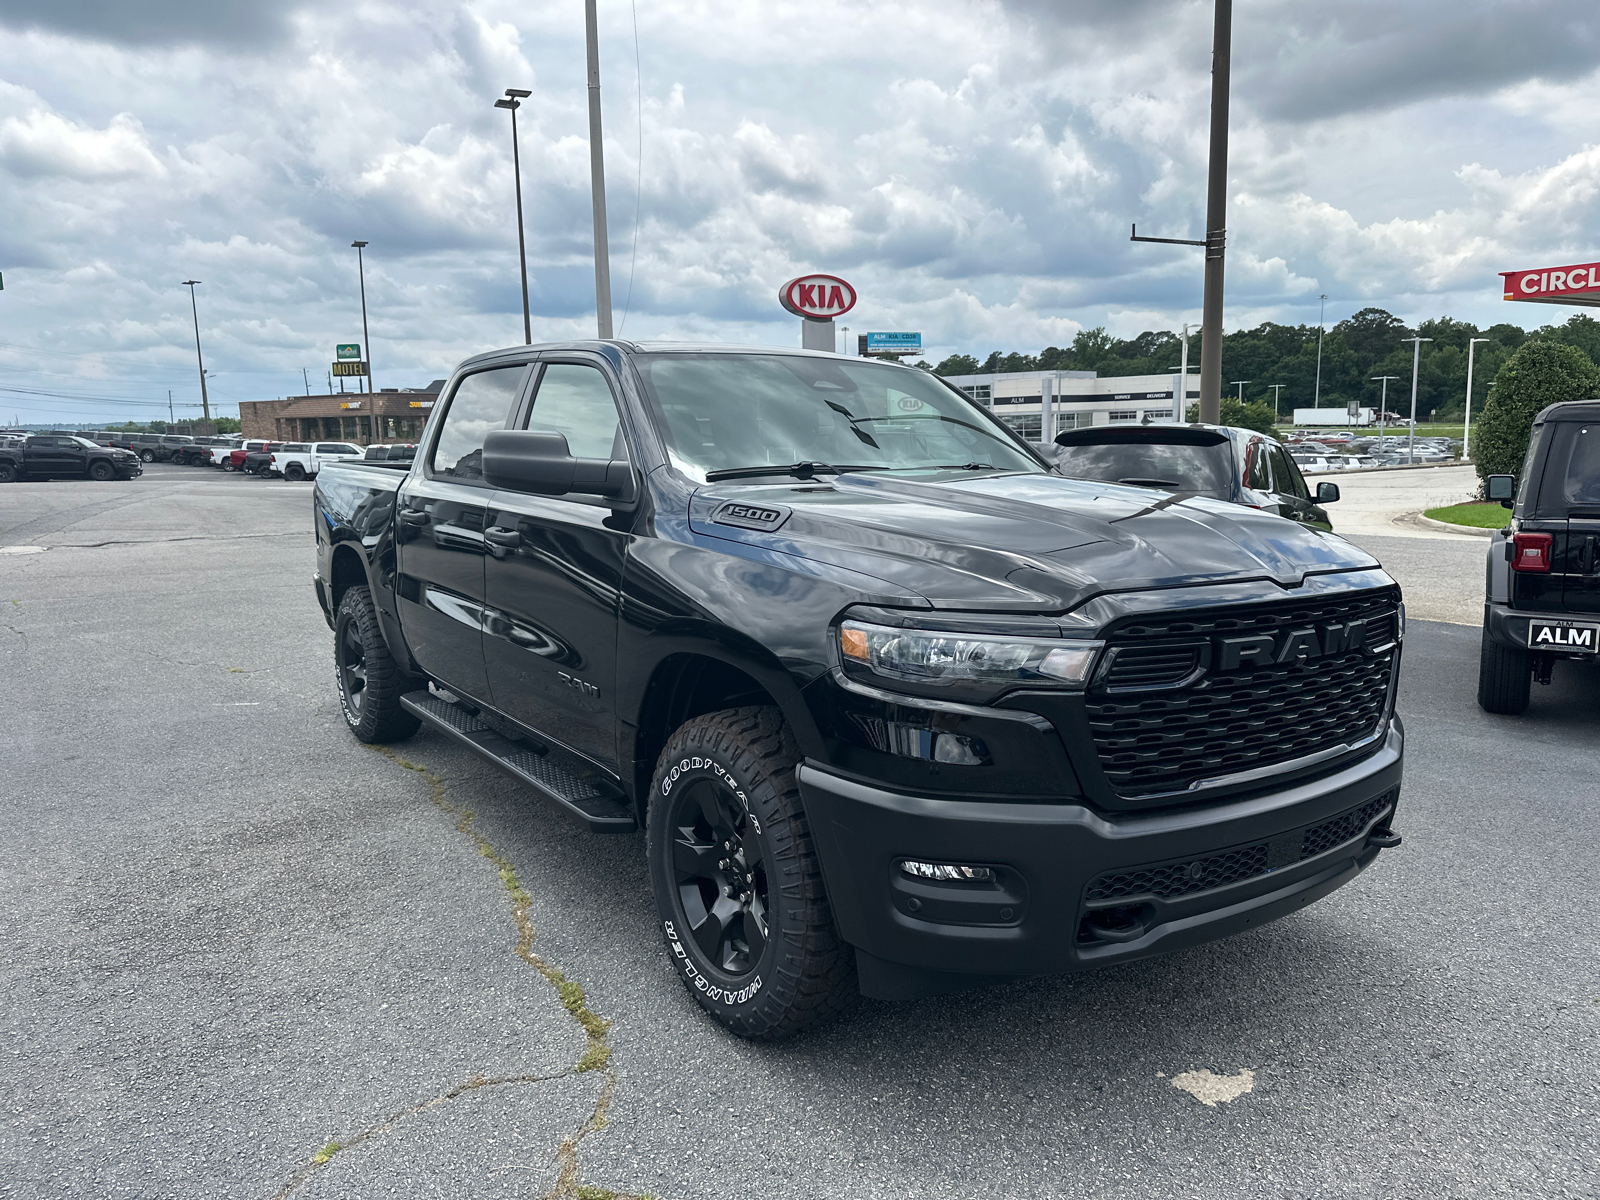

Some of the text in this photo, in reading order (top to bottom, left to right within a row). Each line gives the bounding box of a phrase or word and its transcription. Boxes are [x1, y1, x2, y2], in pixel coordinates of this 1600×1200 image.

[1520, 267, 1600, 294] CIRCL
[798, 283, 846, 309] KIA
[333, 363, 365, 375] MOTEL
[902, 399, 920, 408] KIA
[728, 505, 777, 522] 1500
[1220, 619, 1365, 670] RAM
[1536, 626, 1591, 646] ALM
[557, 671, 601, 699] RAM
[662, 757, 761, 834] GOODYEAR
[665, 921, 762, 1004] WRANGLER
